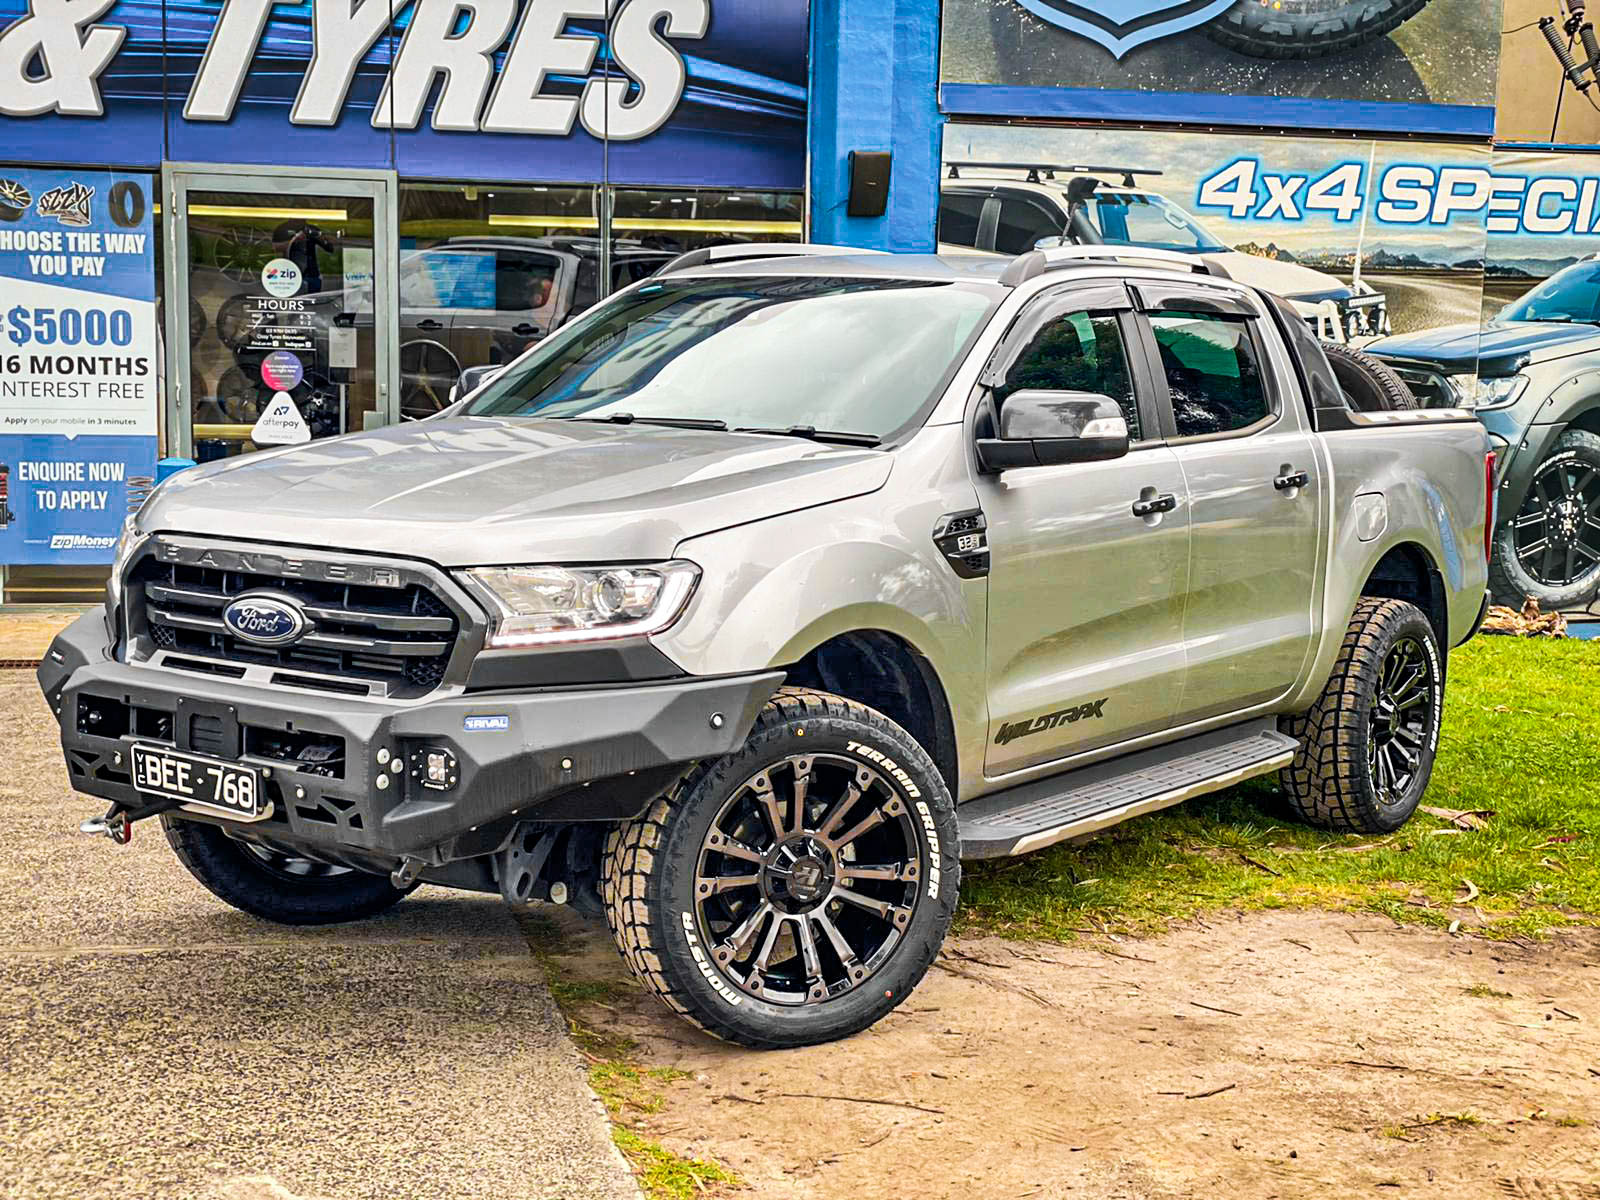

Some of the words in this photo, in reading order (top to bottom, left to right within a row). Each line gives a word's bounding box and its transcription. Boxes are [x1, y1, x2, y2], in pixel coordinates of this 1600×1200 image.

[183, 0, 711, 141] TYRES
[1199, 159, 1364, 221] 4x4
[1376, 165, 1600, 235] SPECI
[66, 232, 101, 253] THE
[104, 233, 147, 254] WAY
[29, 255, 68, 276] YOU
[71, 256, 106, 277] PAY
[280, 268, 297, 280] zip
[258, 300, 305, 311] HOURS
[7, 304, 133, 348] $5000
[30, 355, 149, 376] MONTHS
[98, 382, 145, 399] FREE
[4, 417, 28, 426] Apply
[41, 418, 59, 426] your
[60, 417, 86, 425] mobile
[104, 418, 137, 426] minutes
[263, 418, 300, 429] afterpay
[18, 462, 85, 482] ENQUIRE
[89, 462, 125, 482] NOW
[36, 490, 56, 510] TO
[60, 490, 108, 510] APPLY
[235, 604, 280, 633] Ford
[473, 718, 509, 729] RIVAL
[994, 697, 1109, 746] WILDTRAK
[136, 753, 146, 784] VIC
[145, 754, 194, 795] BEE
[206, 767, 253, 809] 768
[846, 740, 922, 798] TERRAIN
[915, 801, 941, 900] GRIPPER
[681, 911, 743, 1006] MONSTA
